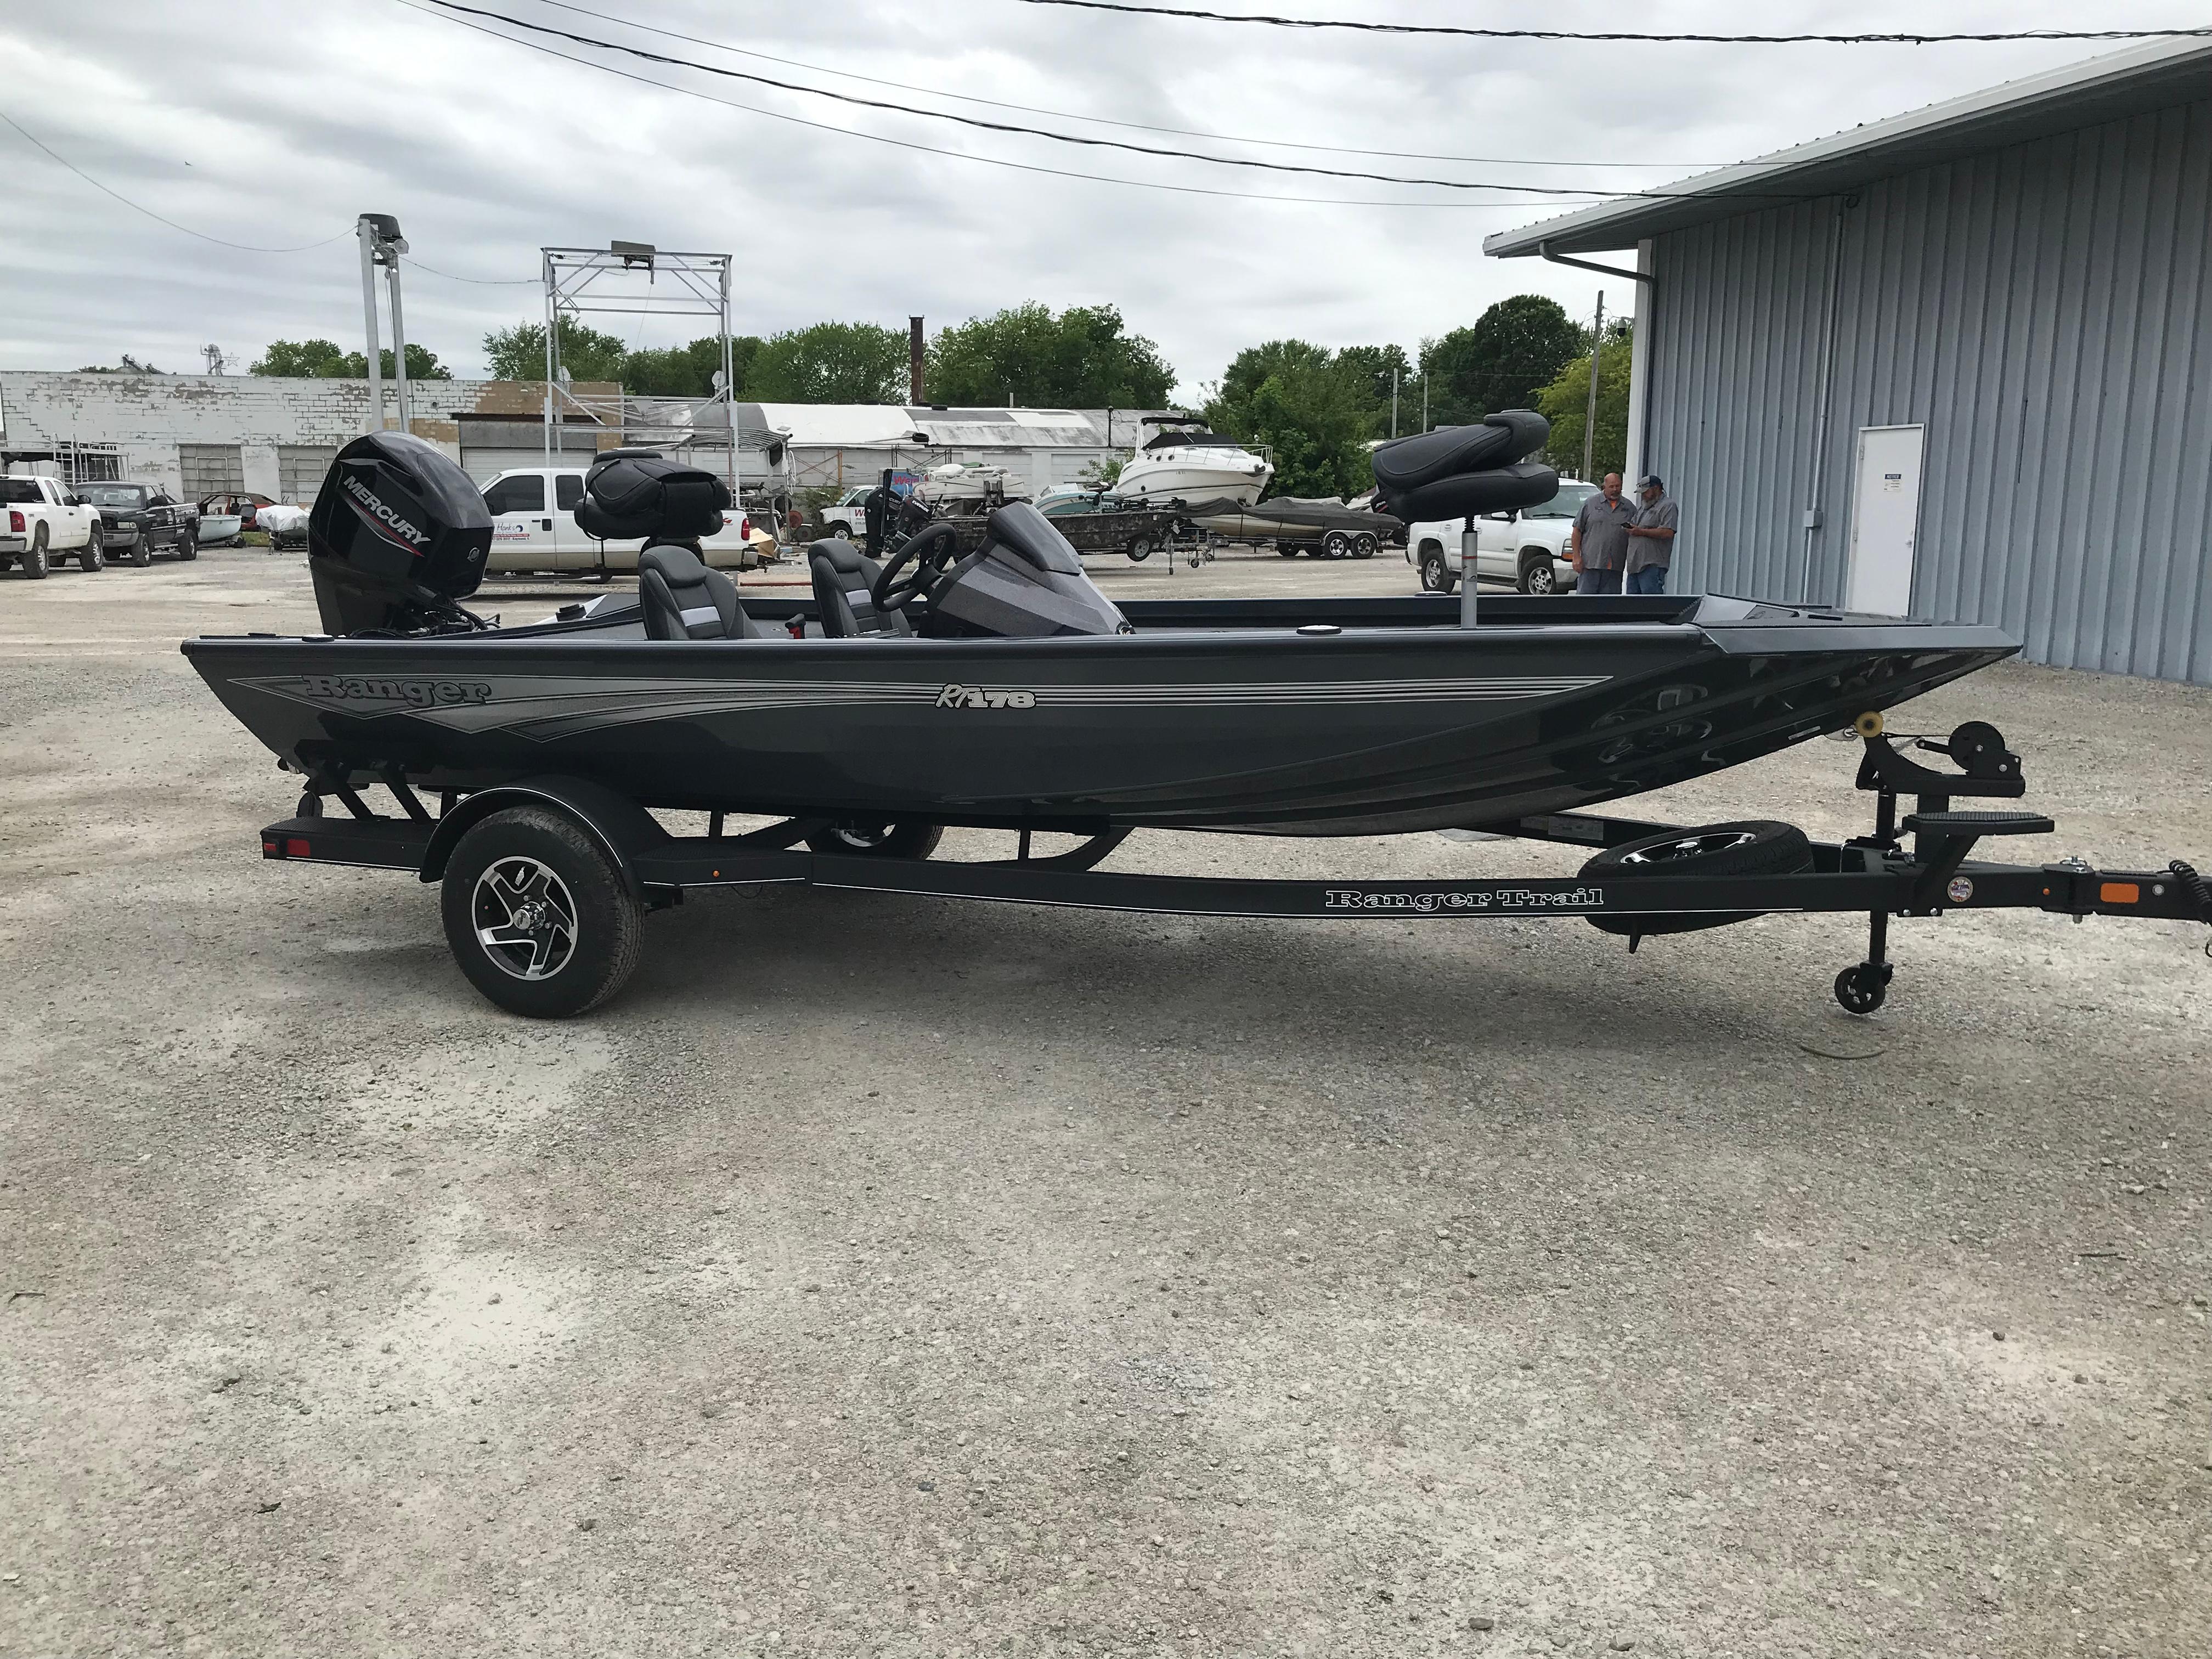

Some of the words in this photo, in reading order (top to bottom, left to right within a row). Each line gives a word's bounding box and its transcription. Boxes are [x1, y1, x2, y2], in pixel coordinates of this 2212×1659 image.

[343, 475, 431, 545] MERCURY
[302, 674, 492, 708] Ranger
[935, 684, 1035, 708] RT178
[1325, 890, 1492, 911] Ranger
[1497, 888, 1604, 906] Trail
